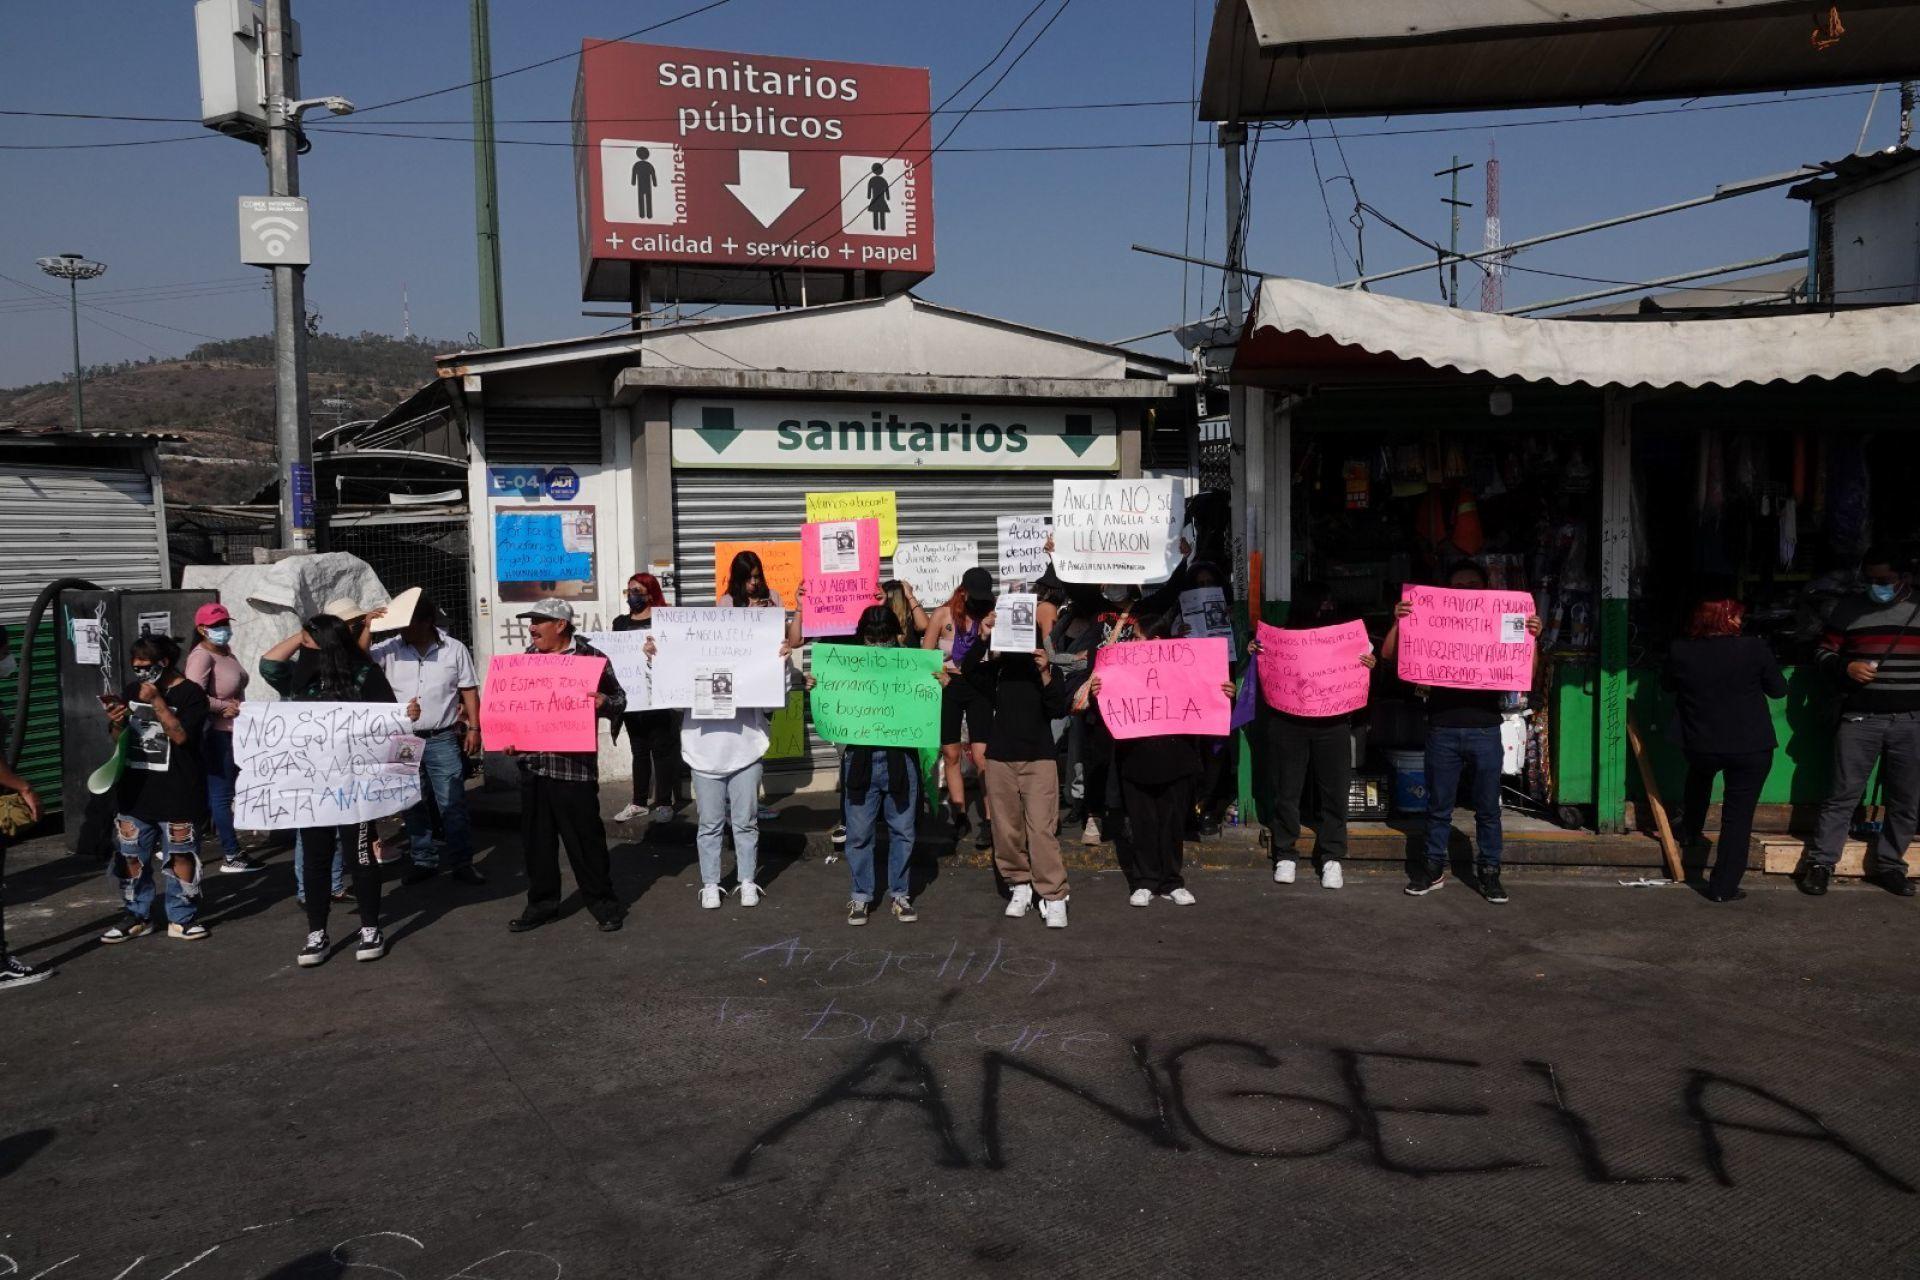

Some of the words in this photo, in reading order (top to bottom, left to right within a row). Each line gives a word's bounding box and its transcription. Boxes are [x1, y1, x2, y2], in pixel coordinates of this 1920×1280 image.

[658, 60, 859, 101] sanitarios
[678, 101, 844, 140] públicos
[631, 233, 713, 254] calidad
[746, 240, 830, 259] servicio
[862, 243, 918, 265] papel
[776, 411, 1028, 453] sanitarios
[493, 475, 540, 489] E-04
[551, 475, 576, 488] ADT
[1063, 486, 1113, 511] ANGELA
[1121, 485, 1150, 512] NO
[1087, 515, 1094, 526] A
[1103, 515, 1144, 526] ANGELA
[1150, 516, 1160, 524] SE
[1165, 516, 1176, 524] LA
[1073, 530, 1150, 552] LLEVARON
[1409, 591, 1434, 609] POR
[1443, 596, 1485, 613] FAVOR
[656, 609, 699, 624] ANGELA
[702, 610, 717, 623] NO
[743, 610, 766, 623] FUE
[1409, 612, 1418, 627] A
[1428, 616, 1493, 634] COMPARTIR
[685, 628, 723, 642] ANGELA
[493, 659, 504, 671] NI
[826, 647, 887, 673] Angelito
[1146, 667, 1160, 690] A
[1426, 663, 1483, 681] QUEREMOS
[1488, 665, 1514, 682] VIVA
[491, 679, 507, 695] NO
[510, 677, 554, 692] ESTAMOS
[883, 682, 890, 701] y
[509, 699, 545, 713] FALTA
[547, 690, 591, 713] ANGELA
[817, 697, 830, 715] te
[1106, 695, 1202, 728] ANGELA
[240, 702, 286, 749] NO
[290, 706, 407, 753] ESTAMOS
[854, 726, 871, 739] de
[243, 749, 316, 781] TODAS
[320, 748, 381, 782] NOS
[237, 782, 316, 826] FALTA
[728, 1033, 1918, 1197] ANGELA
